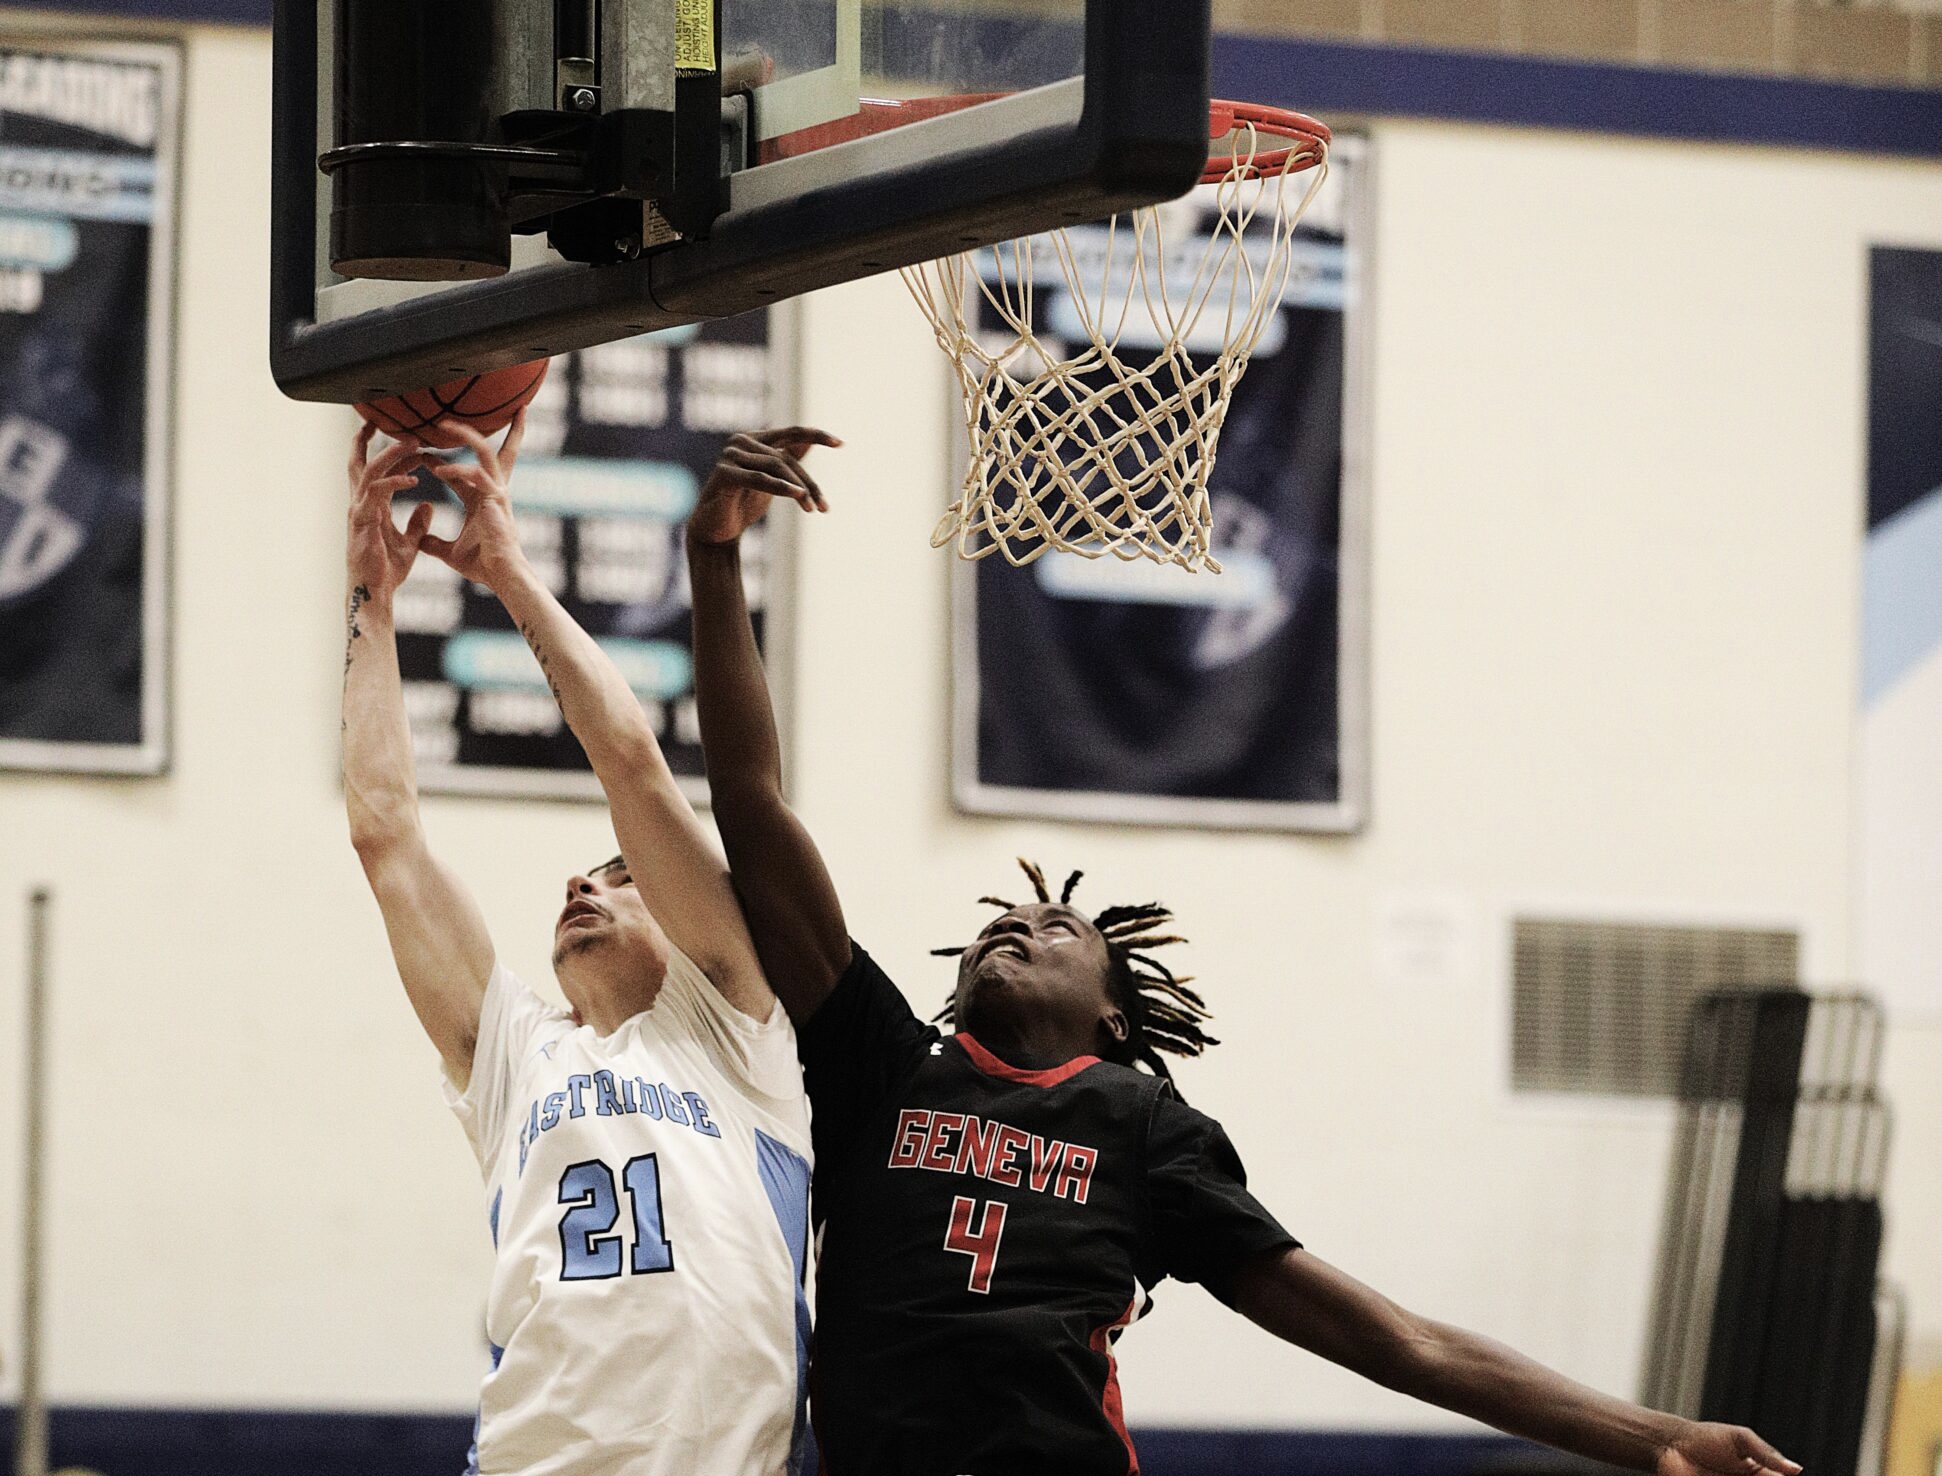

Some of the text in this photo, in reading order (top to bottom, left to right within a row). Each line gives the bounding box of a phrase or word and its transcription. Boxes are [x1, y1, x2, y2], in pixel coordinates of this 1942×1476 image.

[682, 0, 691, 62] ADJUST GO
[692, 0, 700, 62] HOISTING UN
[701, 28, 709, 63] HEIGHT
[888, 1108, 1099, 1205] GENEVA
[557, 1152, 675, 1281] 21
[943, 1195, 1008, 1295] 4
